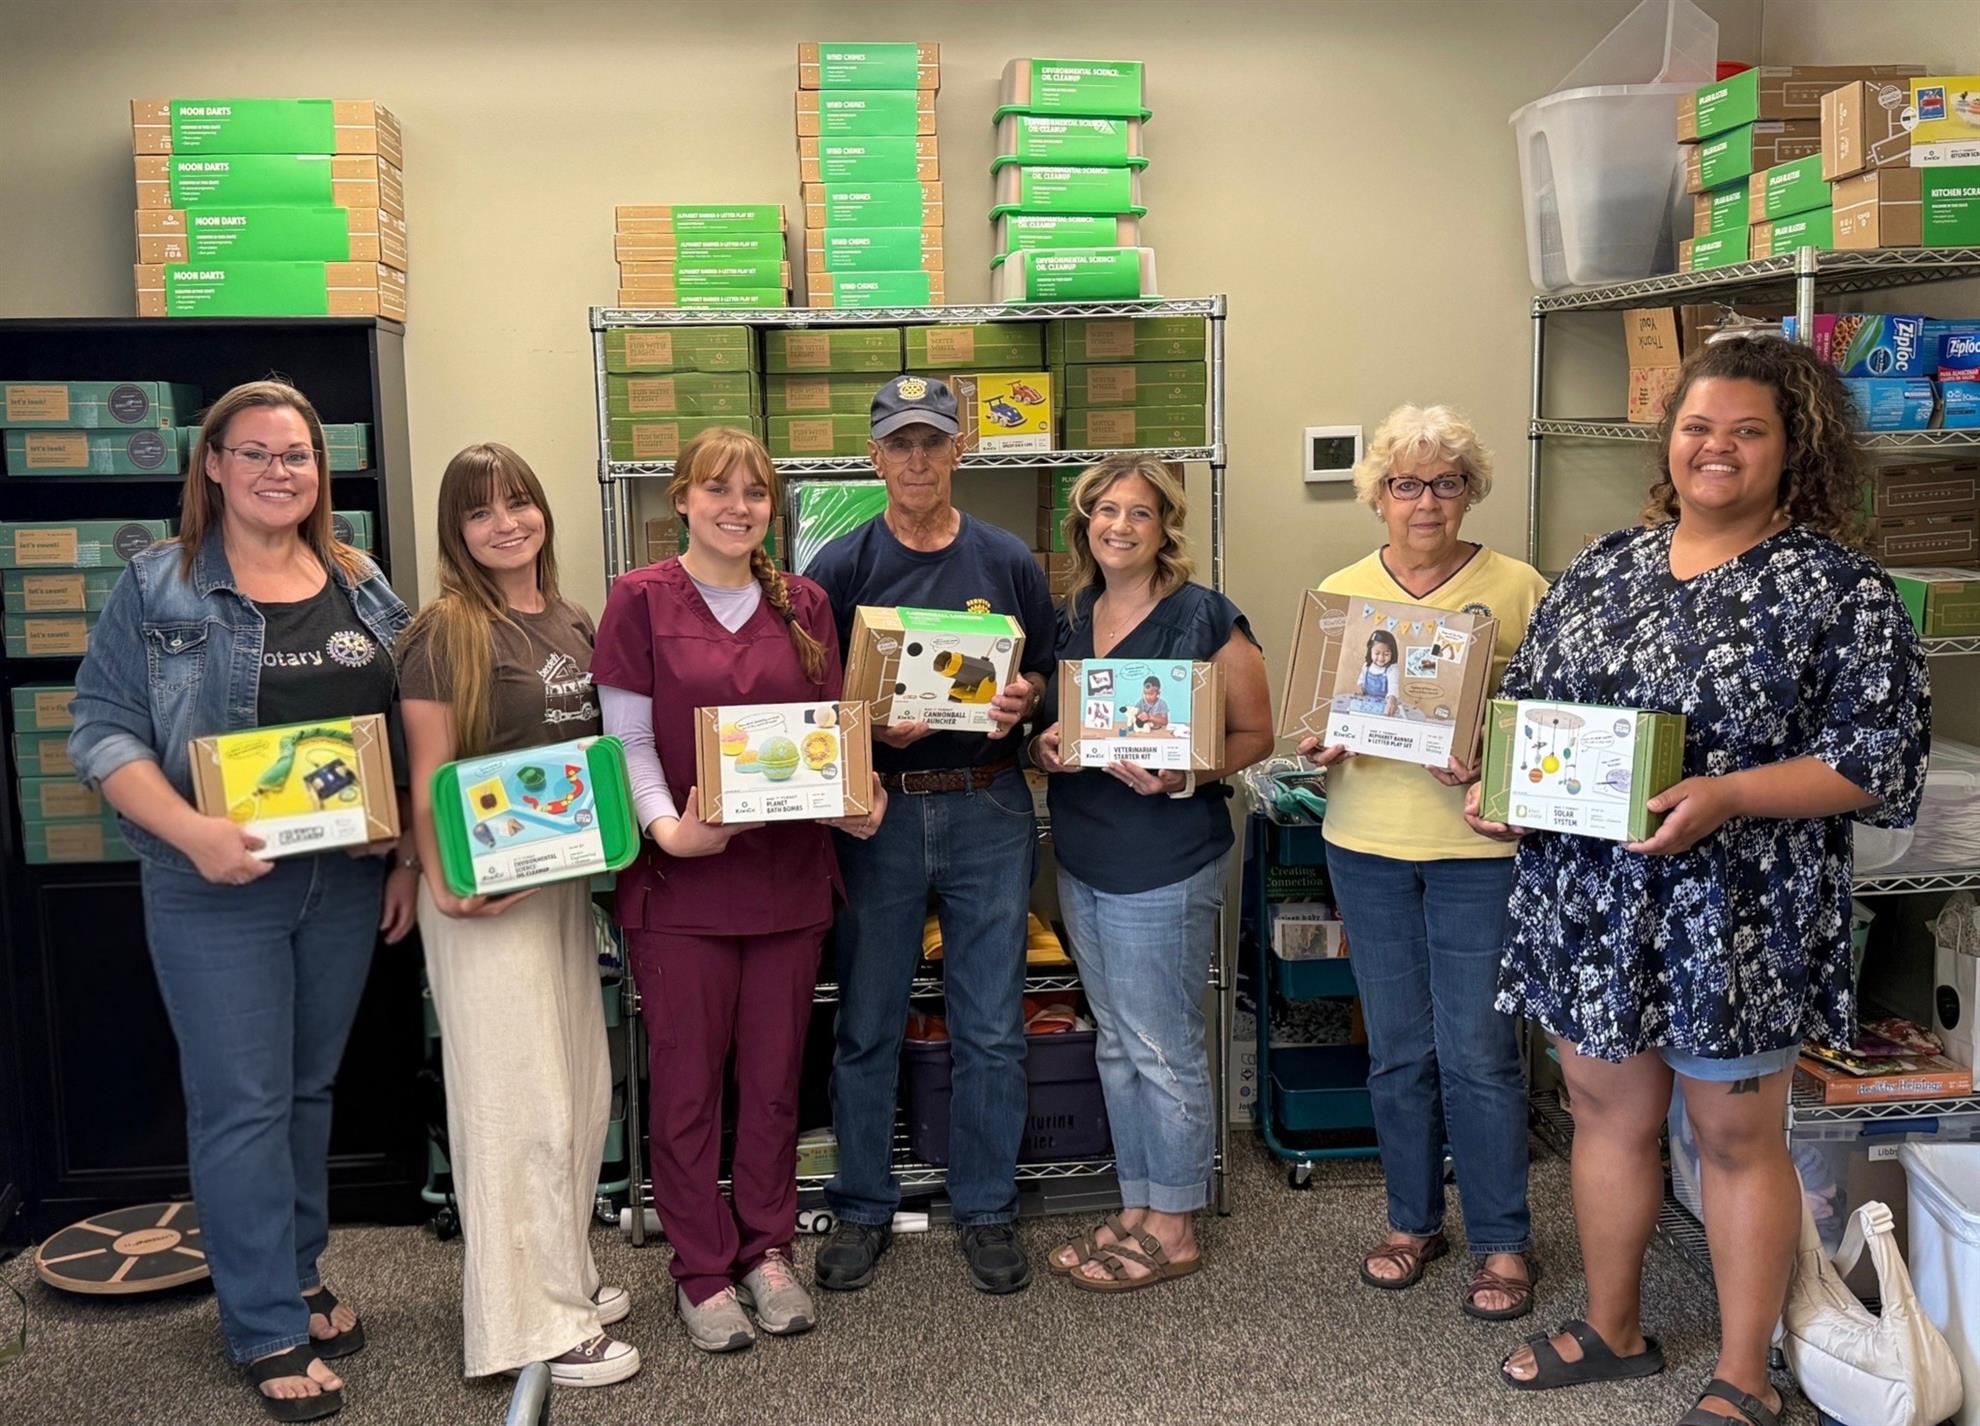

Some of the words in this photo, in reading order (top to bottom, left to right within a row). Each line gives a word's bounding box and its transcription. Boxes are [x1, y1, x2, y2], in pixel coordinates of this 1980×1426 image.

[180, 107, 204, 116] MOON
[206, 107, 232, 116] DARTS
[178, 162, 203, 172] MOON
[204, 162, 230, 172] DARTS
[1931, 188, 1962, 197] KITCHEN
[195, 216, 221, 226] MOON
[222, 216, 246, 226] DARTS
[174, 271, 199, 280] MOON
[200, 271, 224, 280] DARTS
[1638, 335, 1664, 349] Thank
[1893, 323, 1914, 371] Ziploc
[261, 649, 323, 667] otary
[1369, 733, 1392, 741] ALPHABET
[1394, 735, 1413, 743] BANNER
[1554, 809, 1574, 817] SOLAR
[1554, 817, 1577, 826] SYSTEM
[1270, 866, 1316, 876] Creating
[1857, 1079, 1897, 1095] Healthy
[1900, 1077, 1943, 1093] Helpings
